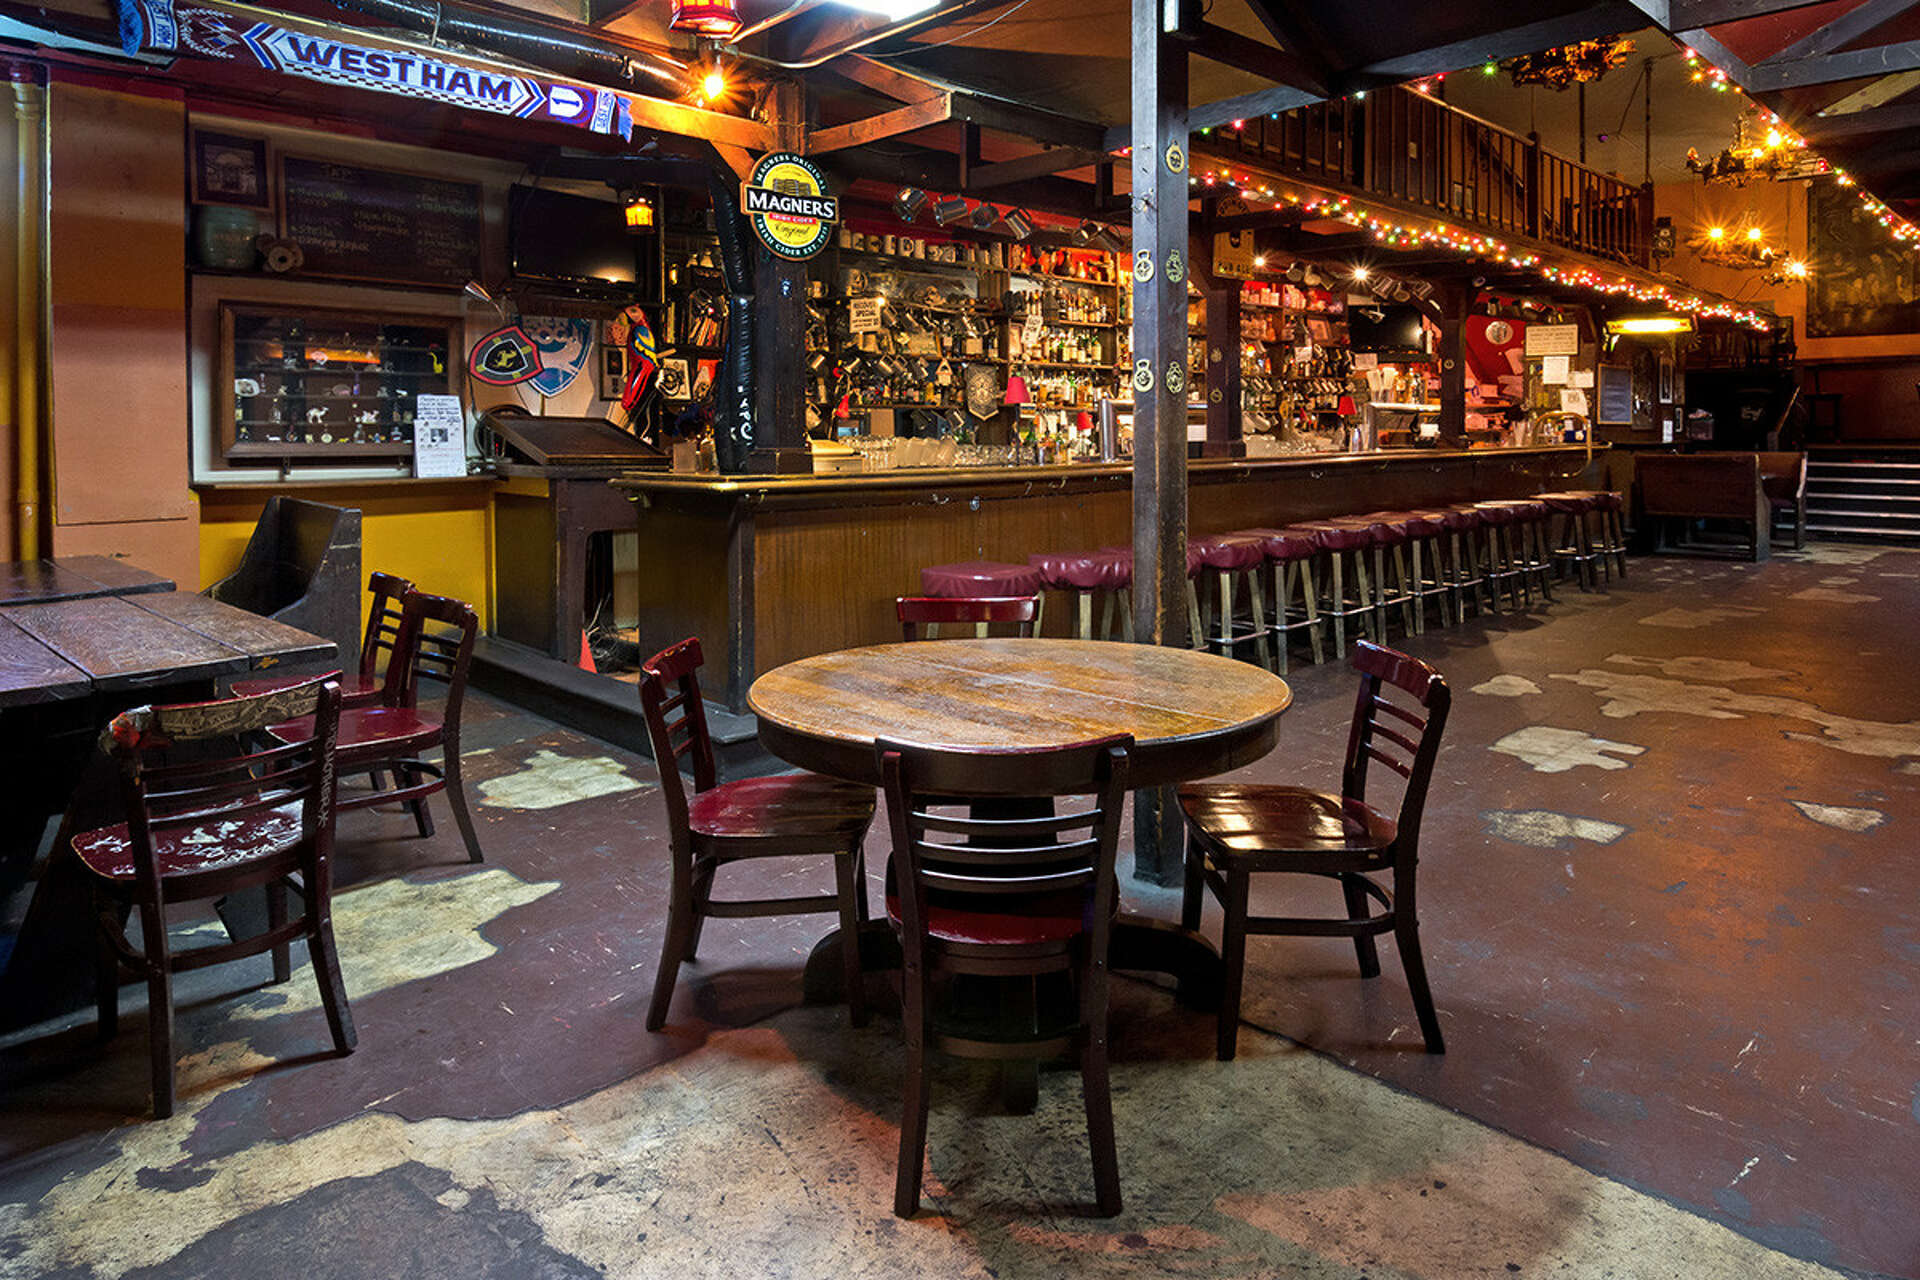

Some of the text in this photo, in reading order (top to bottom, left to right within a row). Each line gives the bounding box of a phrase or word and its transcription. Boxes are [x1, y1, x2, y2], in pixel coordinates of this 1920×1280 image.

[288, 37, 512, 103] WEST HAM
[748, 189, 834, 218] MAGNERS
